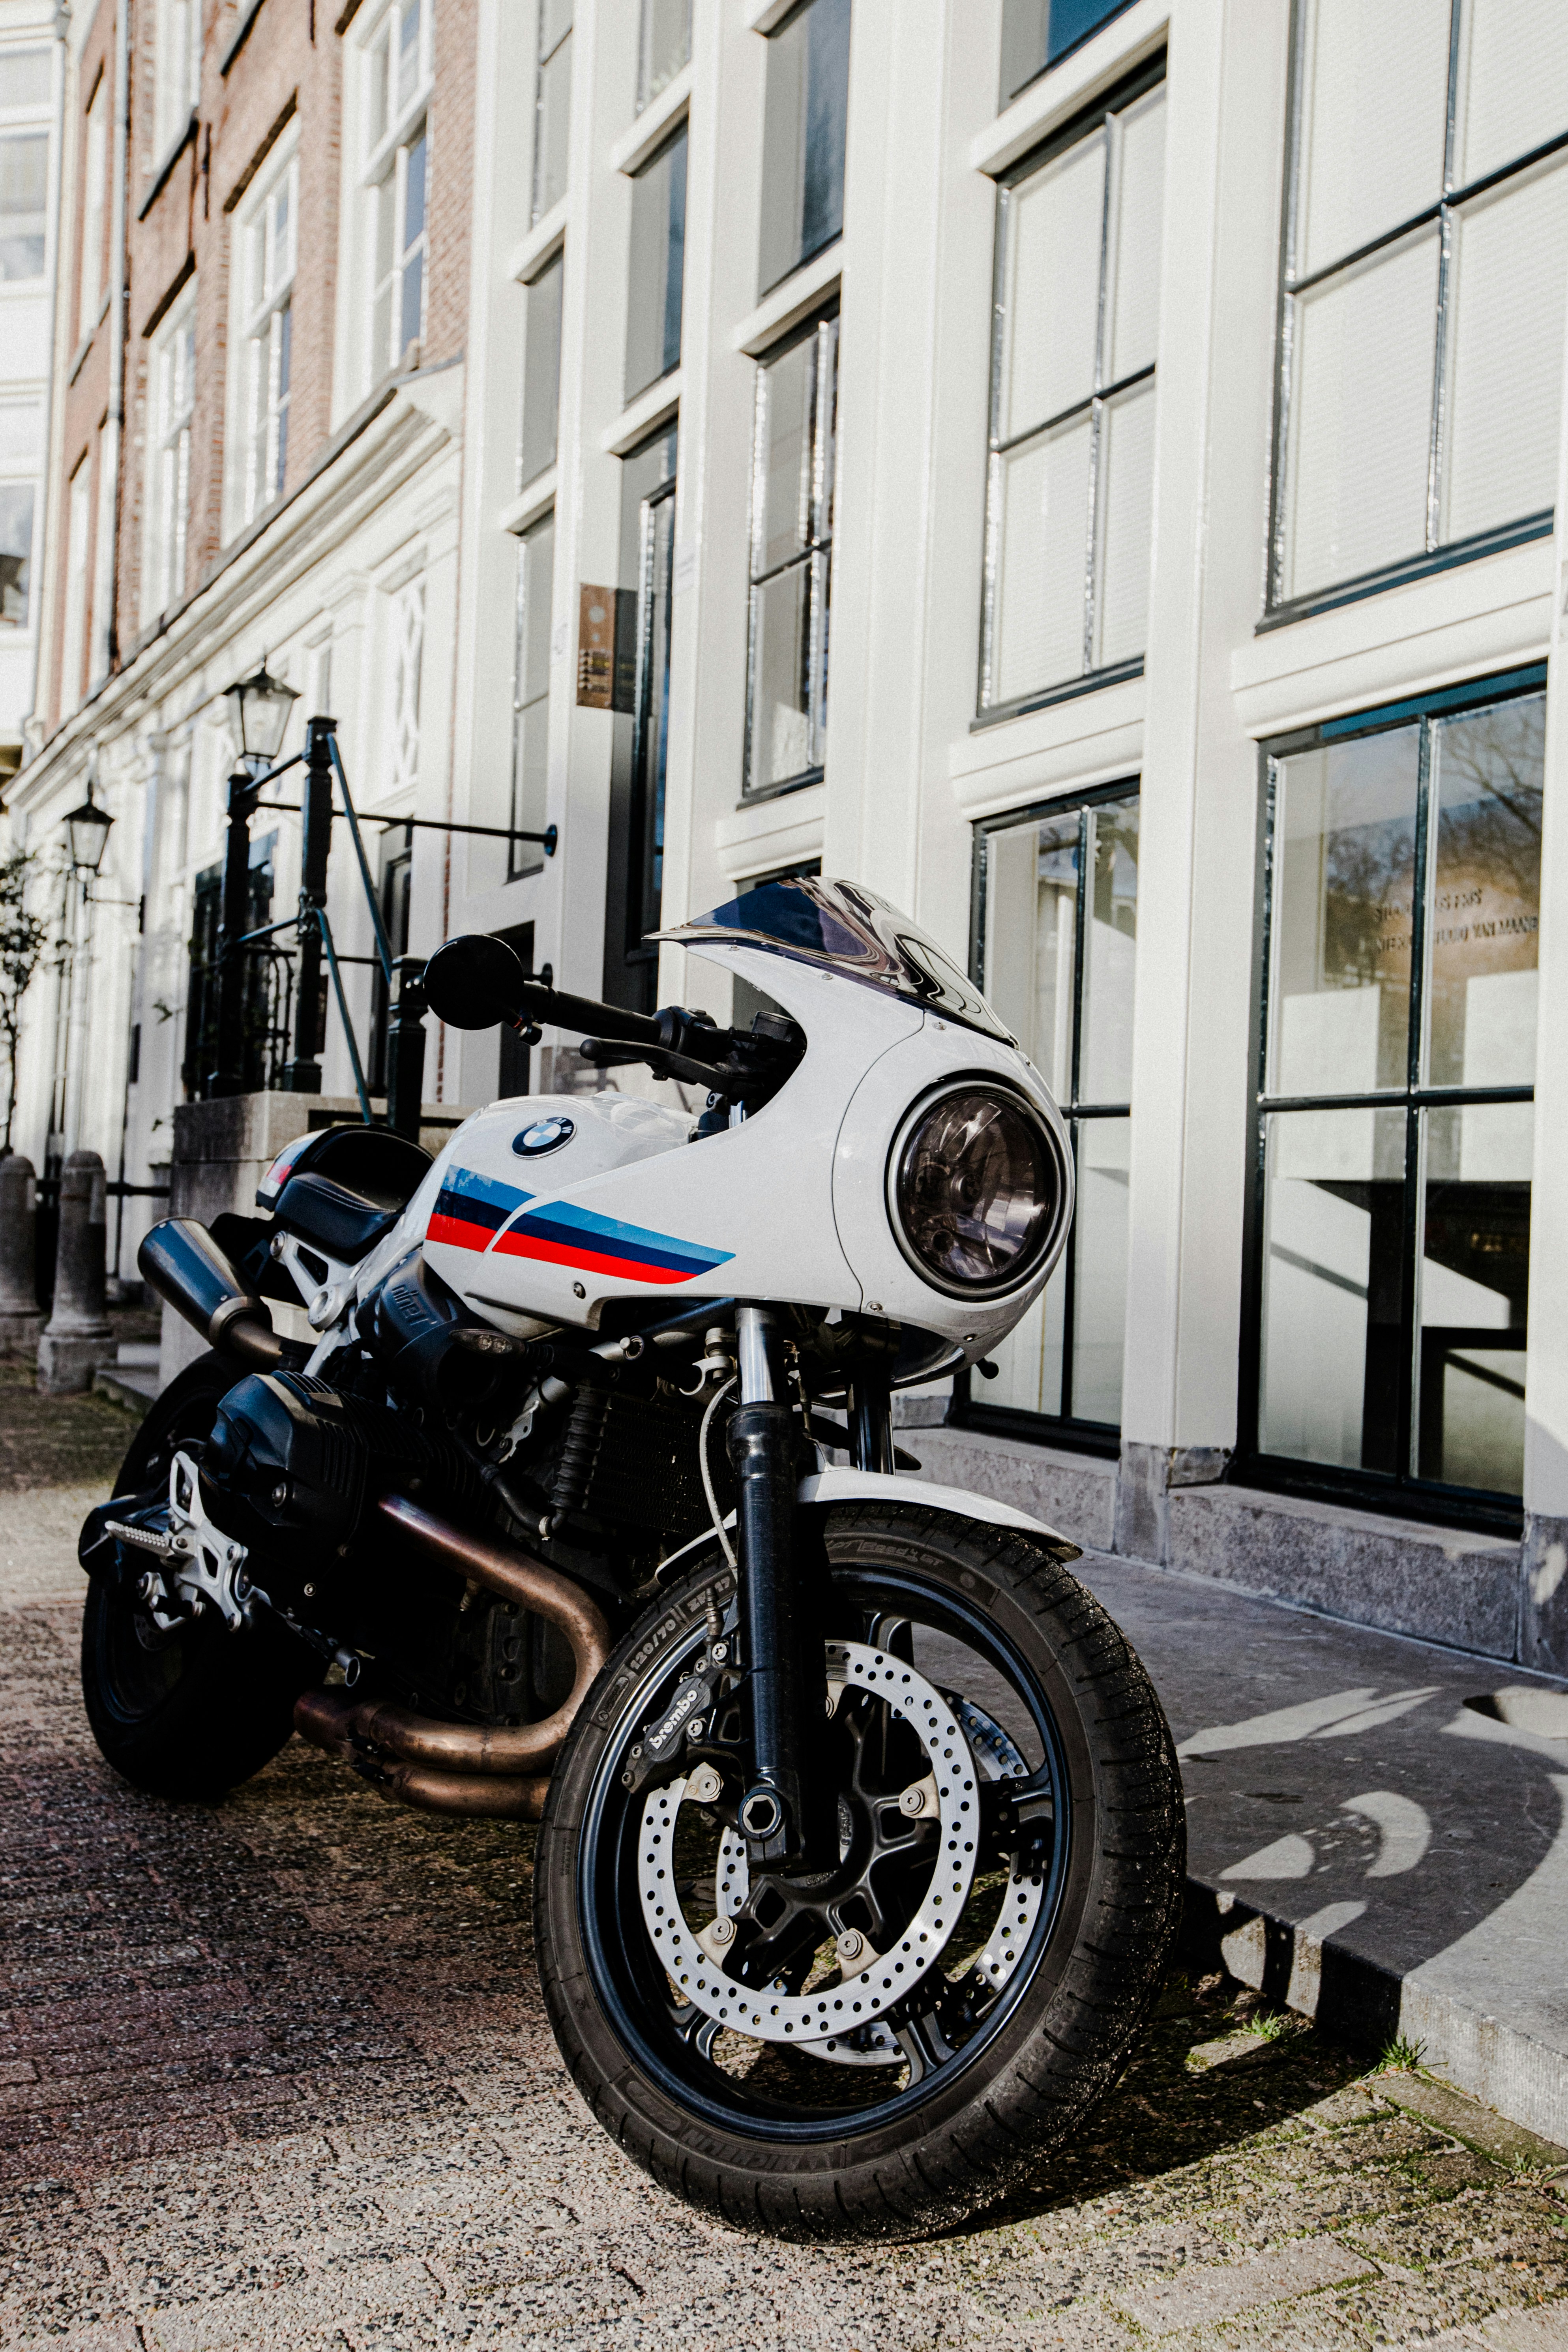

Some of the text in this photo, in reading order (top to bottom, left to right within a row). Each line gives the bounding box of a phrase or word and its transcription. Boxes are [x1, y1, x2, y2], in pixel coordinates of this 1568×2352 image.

[537, 1117, 573, 1134] BMW
[714, 1576, 731, 1593] 17
[630, 1619, 676, 1670] 120/70
[649, 1690, 697, 1750] brembo
[682, 2128, 800, 2170] MICHELIN
